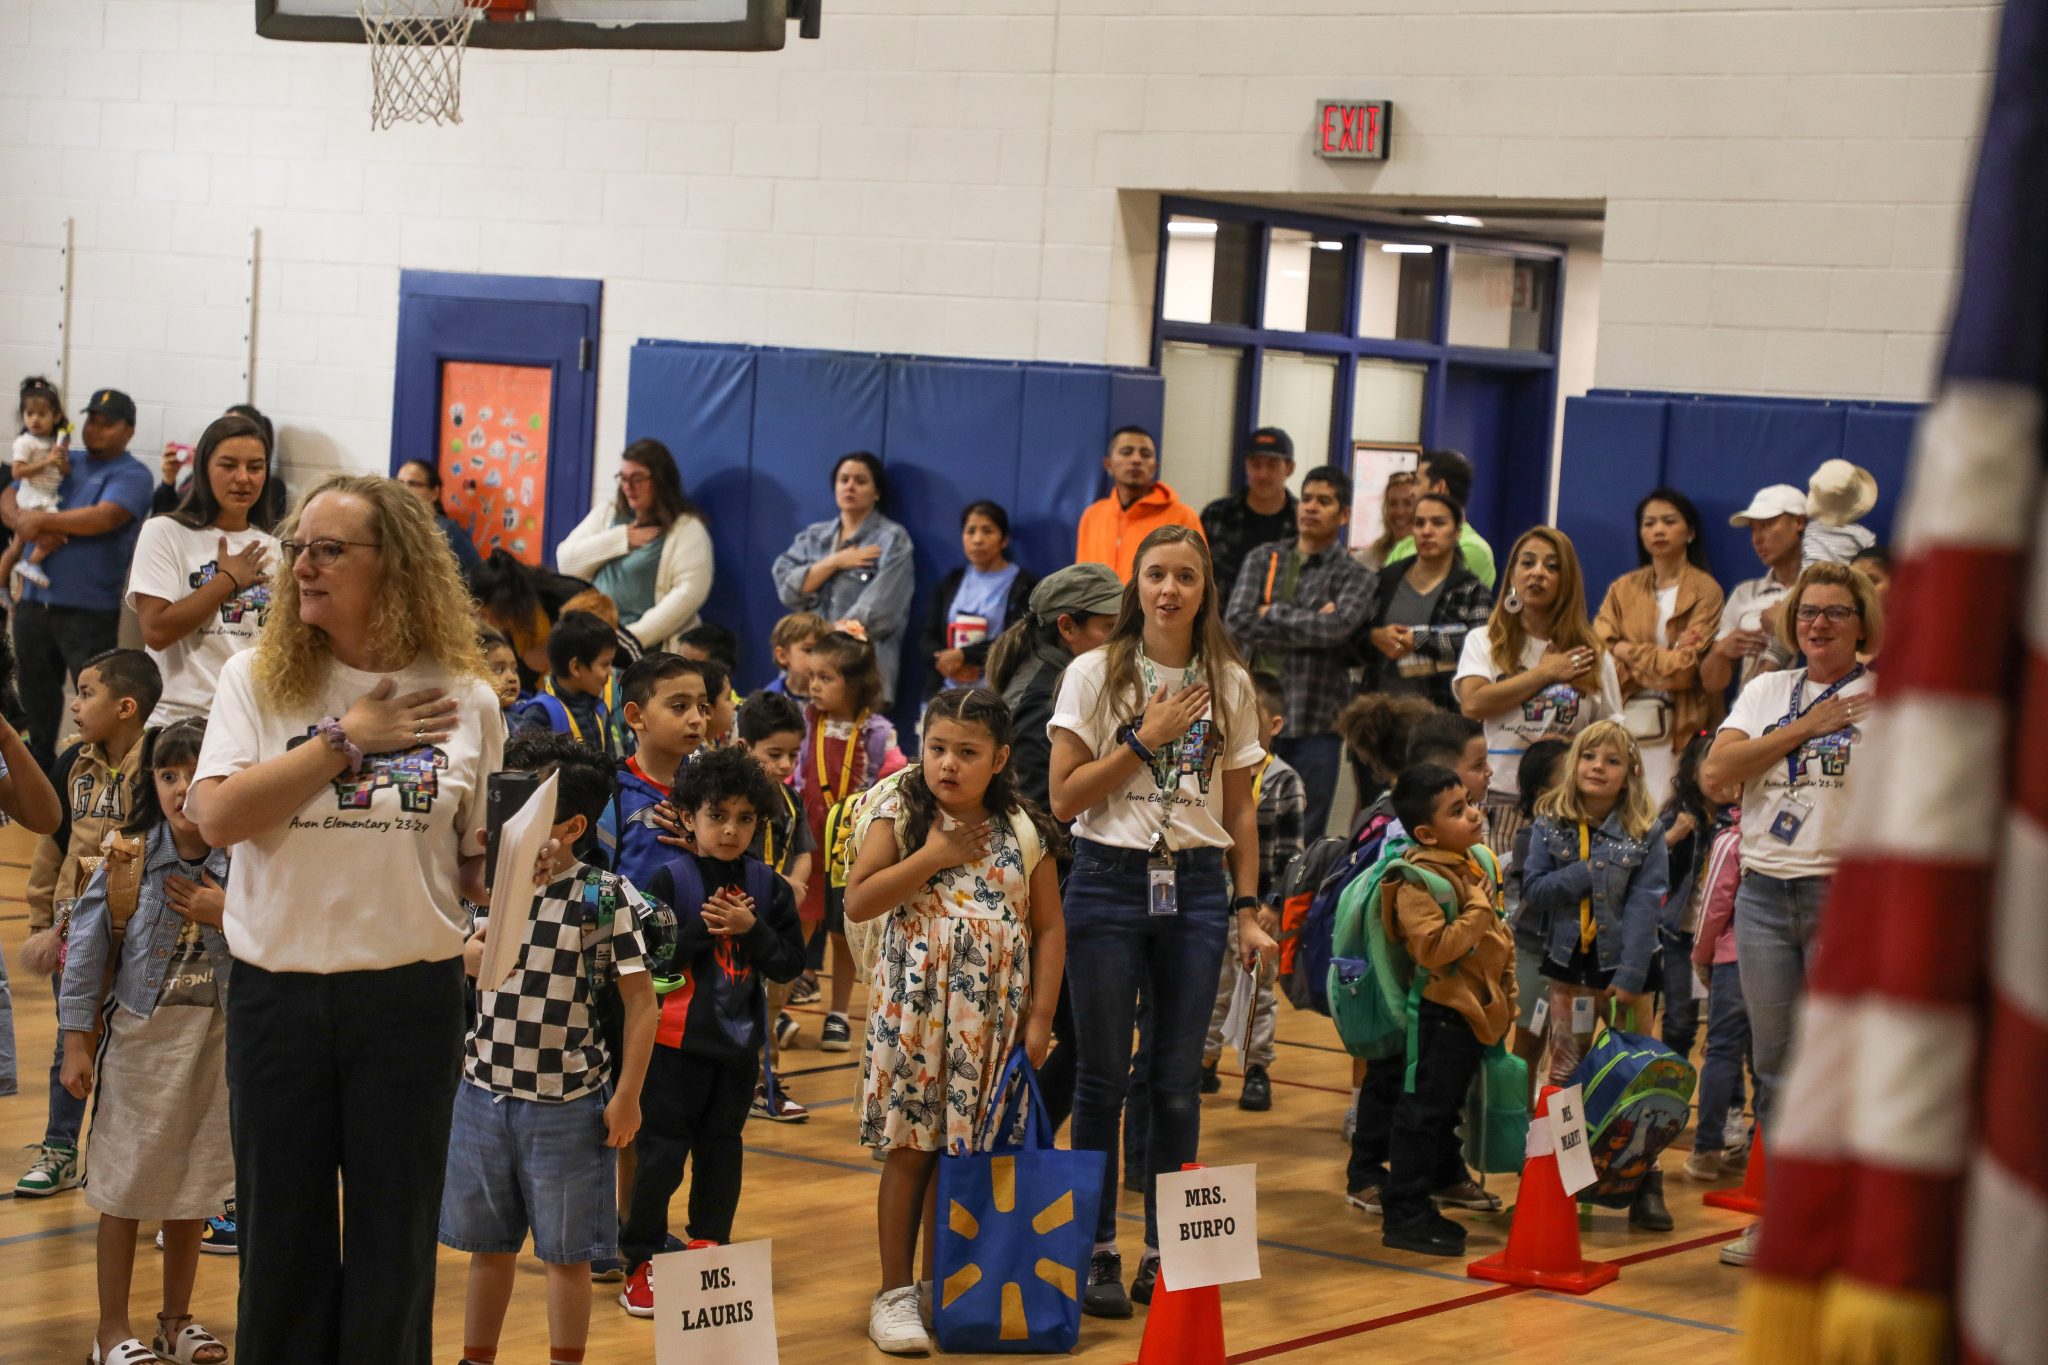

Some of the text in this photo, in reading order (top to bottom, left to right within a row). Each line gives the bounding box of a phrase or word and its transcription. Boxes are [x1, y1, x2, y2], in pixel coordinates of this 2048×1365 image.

[1323, 105, 1381, 152] EXIT
[1126, 791, 1145, 801] Avon
[289, 816, 430, 833] Avon Elementary '23-'24
[1185, 1185, 1227, 1208] MRS.
[1179, 1216, 1236, 1242] BURPO
[700, 1266, 736, 1291] MS.
[681, 1300, 754, 1331] LAURIS
